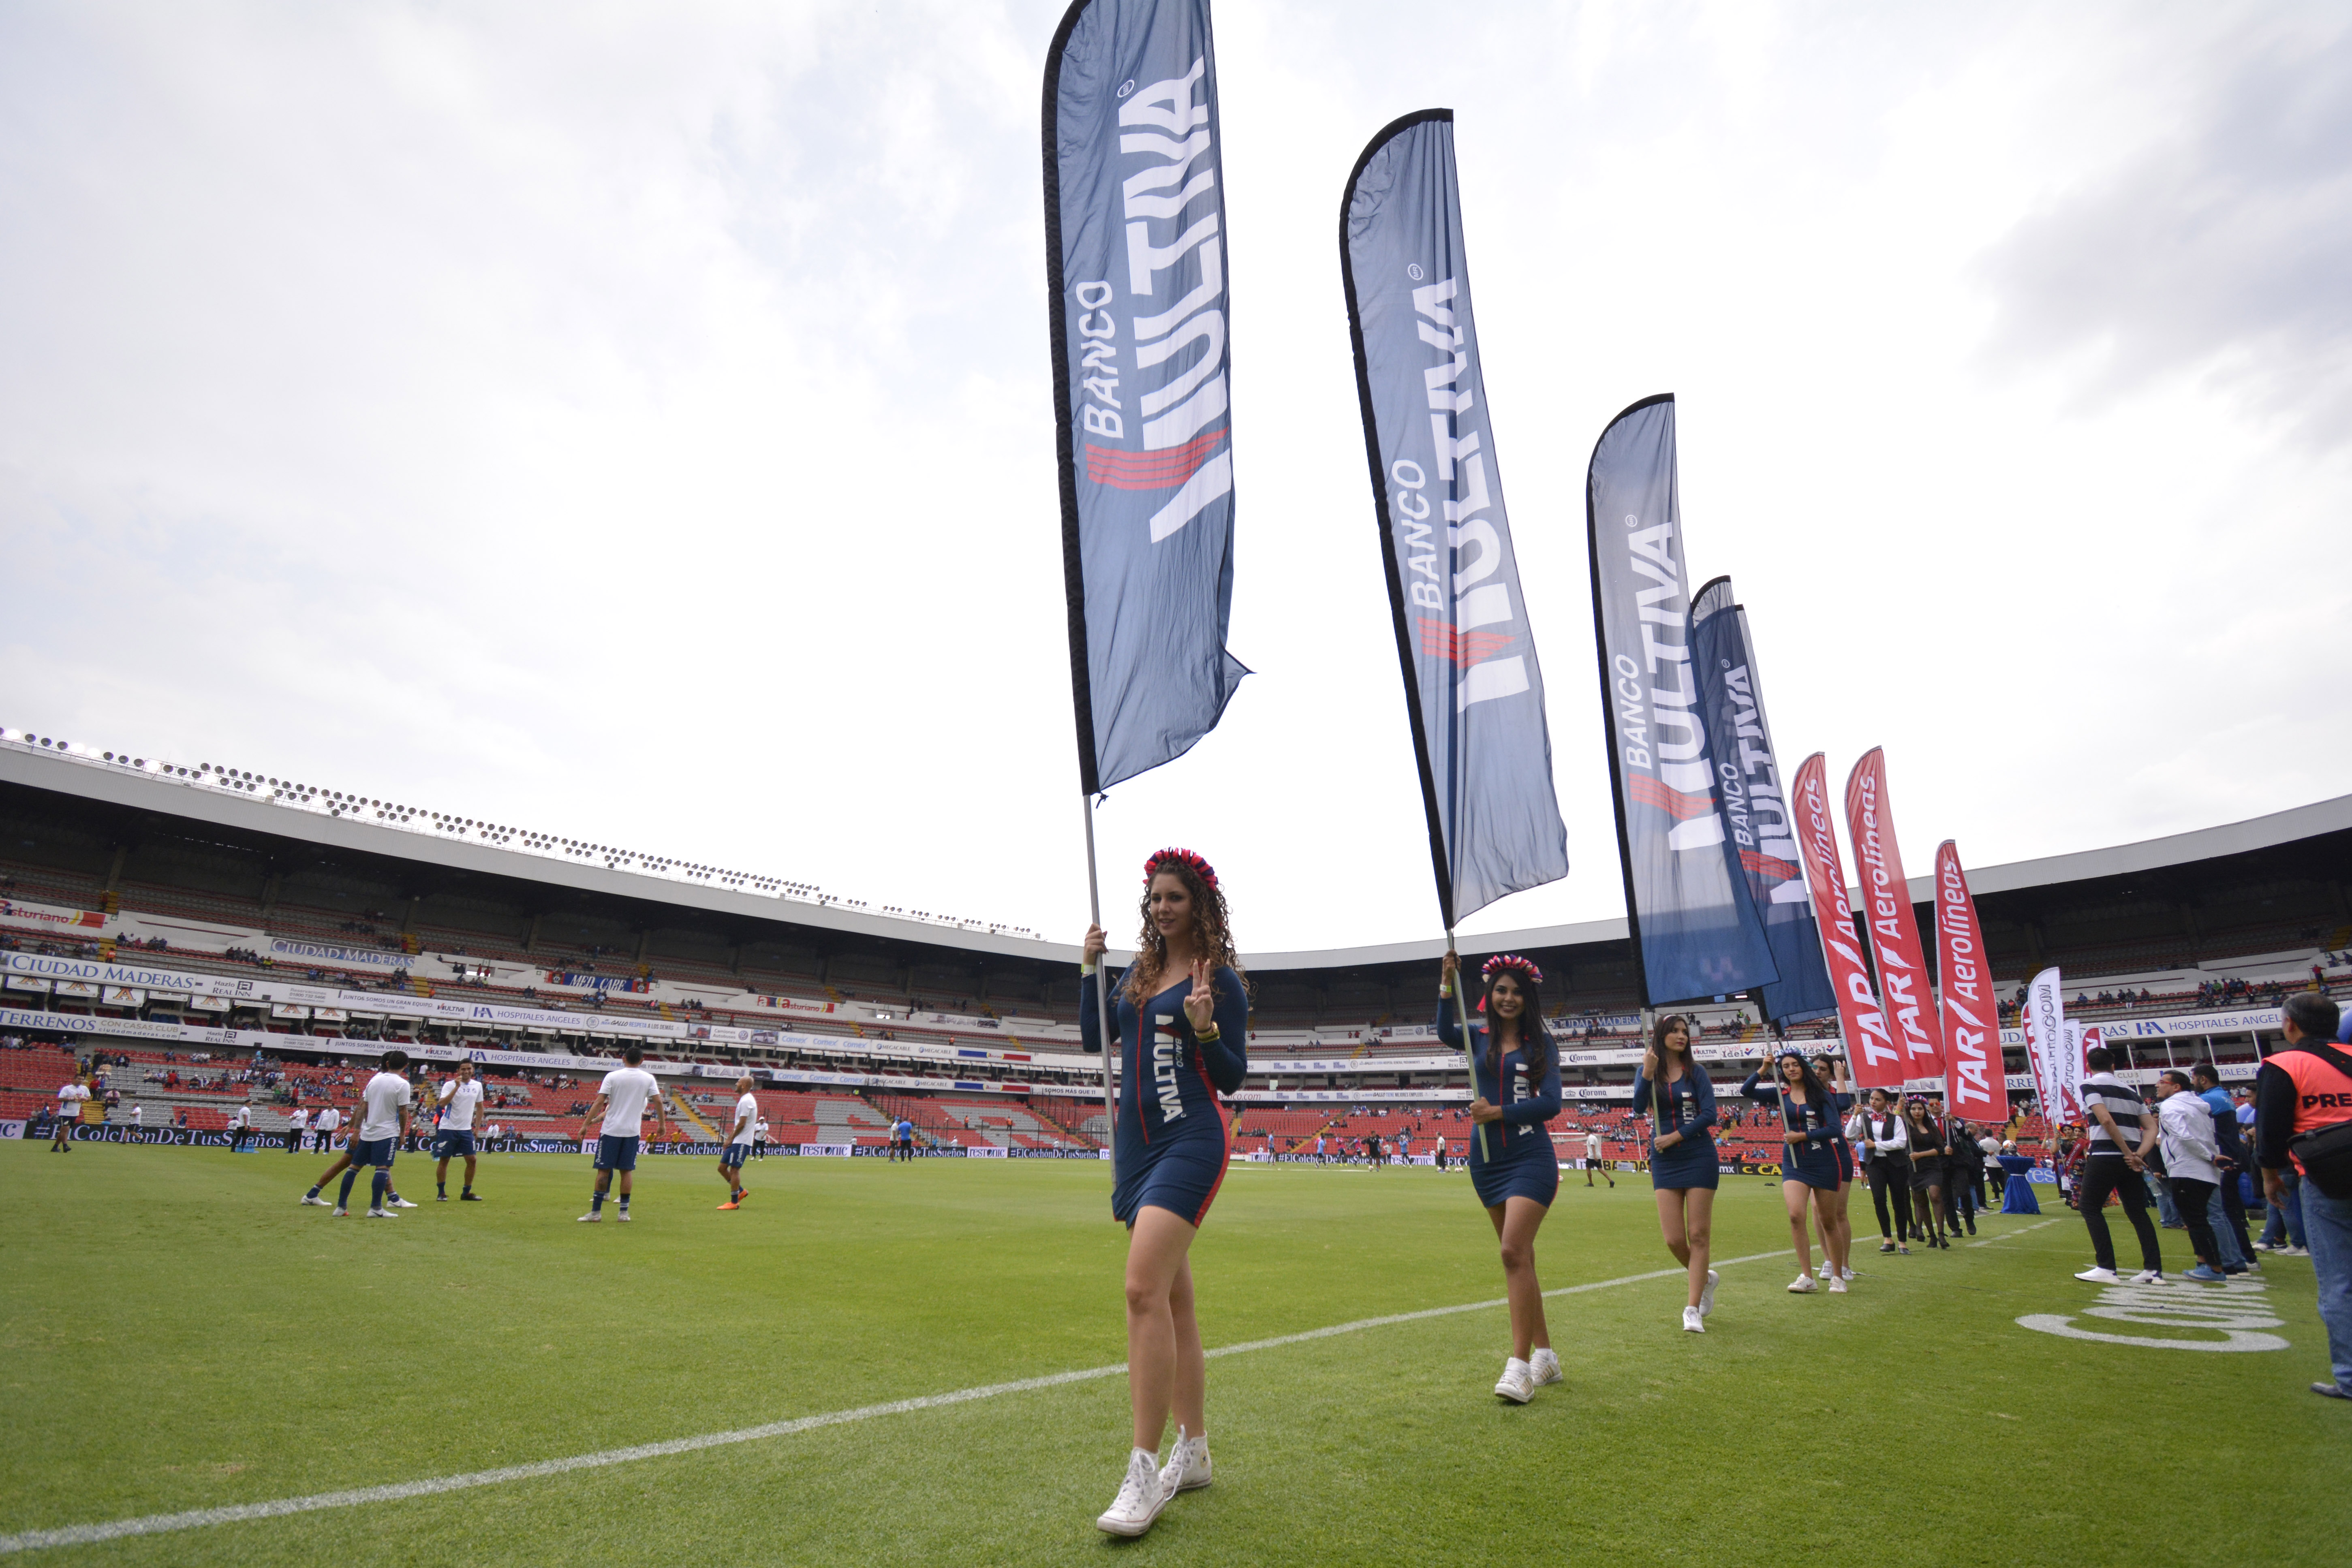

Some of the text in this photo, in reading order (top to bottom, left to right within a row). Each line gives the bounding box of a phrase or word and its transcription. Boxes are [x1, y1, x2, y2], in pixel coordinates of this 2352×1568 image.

[1118, 53, 1231, 543] MULTIVA
[1076, 280, 1123, 439] BANCO
[1412, 276, 1530, 714] MULTIVA
[1391, 459, 1444, 611] BANCO
[1628, 522, 1726, 851] MULTIVA
[1615, 655, 1652, 771] BANCO
[1724, 665, 1808, 904] MULTIVA
[1719, 763, 1754, 846] BANCO
[1860, 775, 1933, 1060] TAR Aerolíneas
[272, 940, 415, 968] CIUDAD MADERAS
[12, 956, 194, 988] CIUDAD MADERAS
[1942, 858, 1991, 1104] TAR Aerolíneas
[212, 987, 233, 995] REAL
[569, 975, 626, 991] MED CARE
[437, 1003, 465, 1013] MULTIVA
[498, 1010, 580, 1024] HOSPITALES ANGELES
[0, 1010, 96, 1031] TERRENOS
[124, 1022, 153, 1030] CASAS
[2169, 1014, 2281, 1030] HOSPITALES ANGEL
[98, 1028, 177, 1038] ciudadmaderas.com
[782, 1036, 808, 1044] Comex
[426, 1047, 452, 1055] MULTIVA
[491, 1054, 570, 1066] HOSPITALES ANGELES
[1175, 1038, 1184, 1067] BANCO
[1569, 1054, 1597, 1063] Corona
[707, 1067, 745, 1077] MAN
[1153, 1014, 1184, 1123] MULTIVA
[1579, 1089, 1607, 1098] Corona
[387, 1142, 396, 1161] elektra
[1011, 1148, 1098, 1159] #ElColchónDeTusSueños
